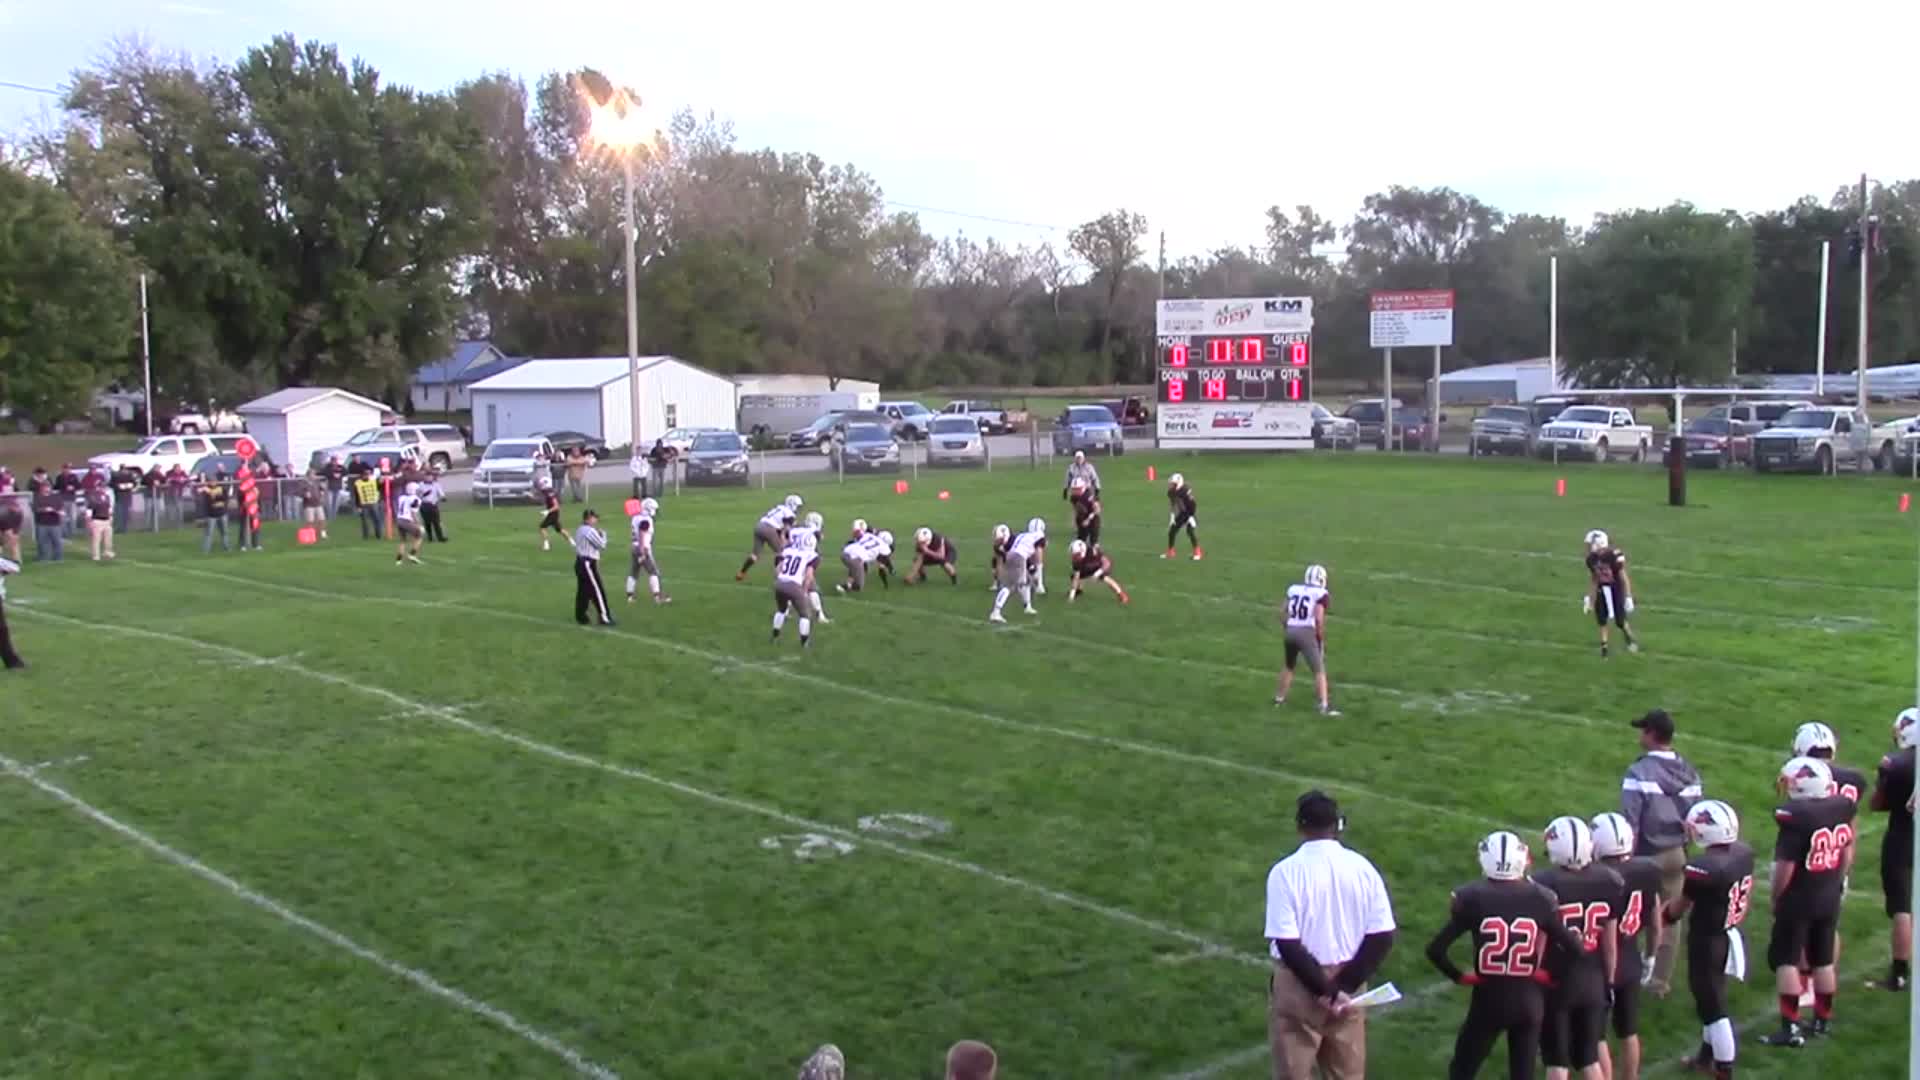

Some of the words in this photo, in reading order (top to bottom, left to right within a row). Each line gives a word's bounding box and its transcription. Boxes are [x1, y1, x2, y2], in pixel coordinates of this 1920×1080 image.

[1158, 336, 1191, 346] HOME
[1172, 345, 1187, 367] 0
[1293, 343, 1306, 364] 0
[1161, 370, 1188, 381] DOWN
[1198, 370, 1209, 380] TO
[1212, 370, 1226, 380] GO
[1236, 369, 1259, 380] BALL
[1261, 369, 1275, 380] ON
[1168, 380, 1183, 400] 2
[1206, 379, 1225, 399] 14
[1290, 379, 1300, 399] 1
[782, 555, 801, 576] 30
[1290, 594, 1311, 620] 36
[1479, 916, 1538, 976] 22
